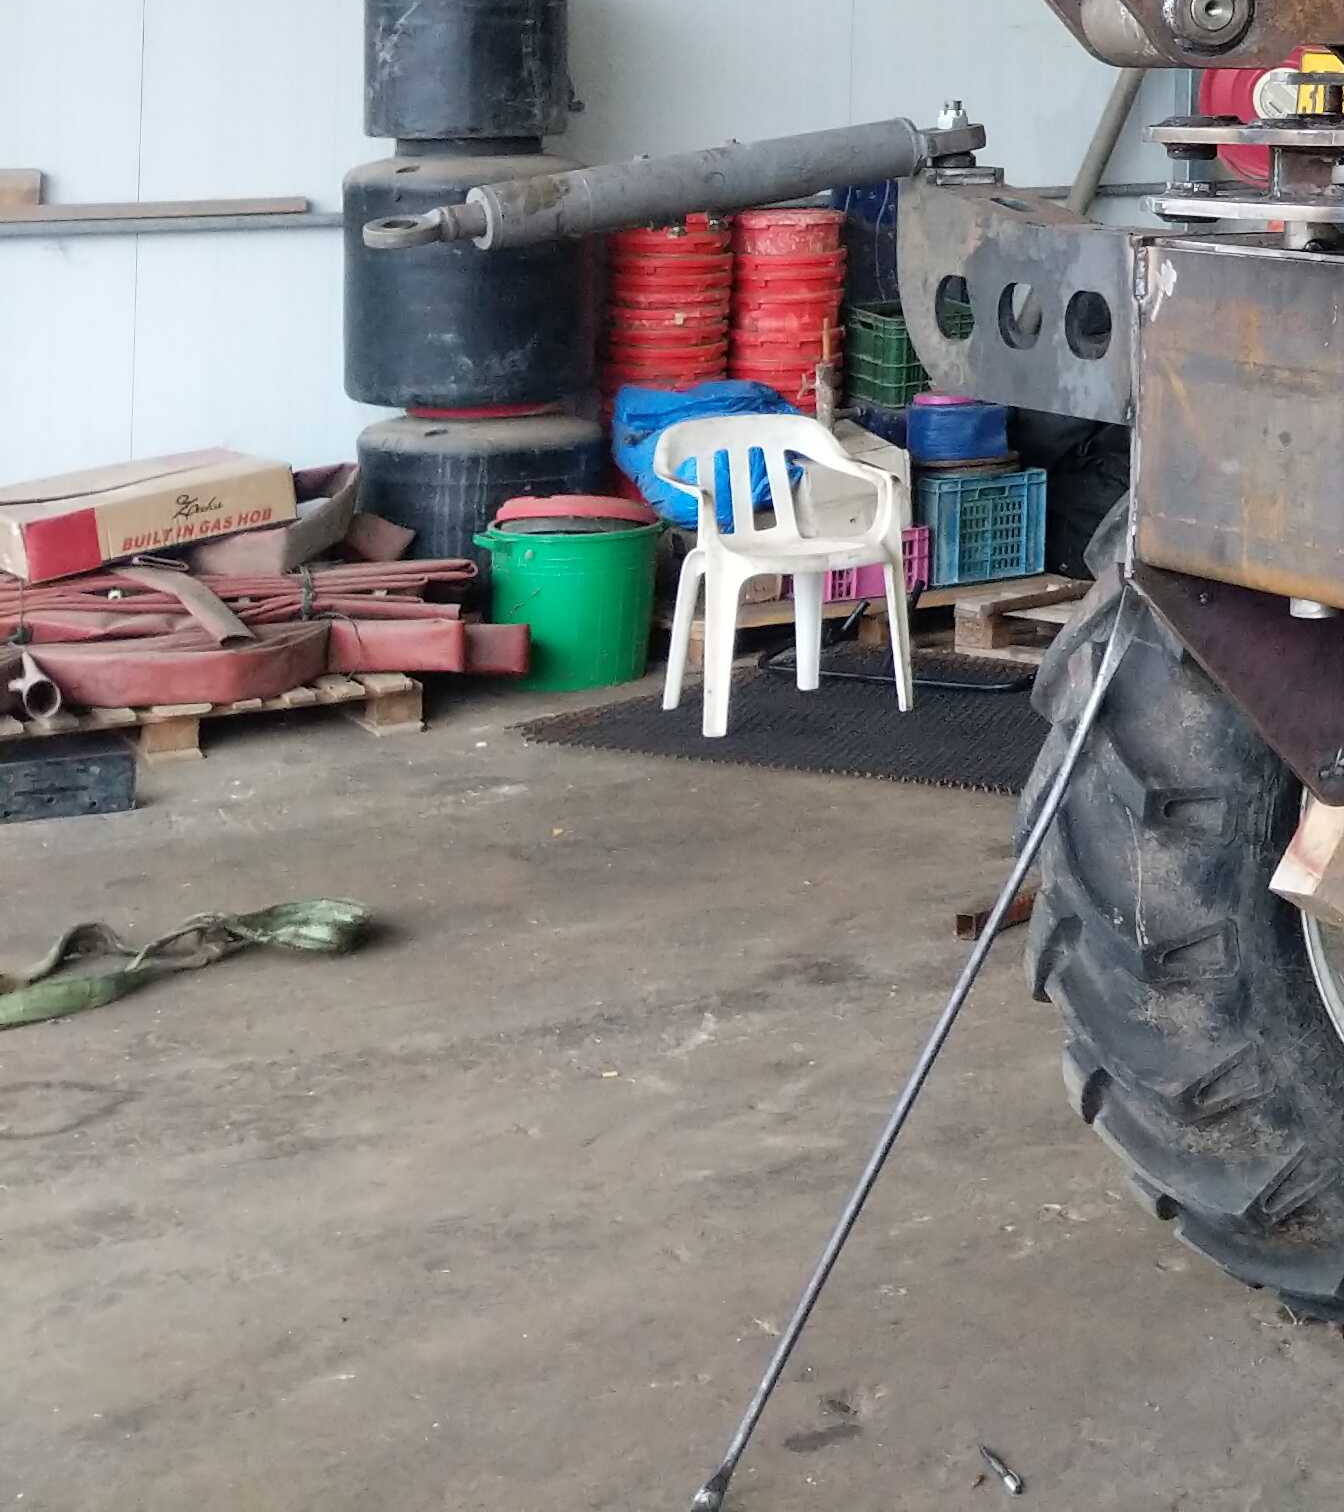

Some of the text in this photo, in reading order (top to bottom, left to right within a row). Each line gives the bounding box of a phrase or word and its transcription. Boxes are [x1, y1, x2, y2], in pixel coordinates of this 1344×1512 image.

[122, 527, 172, 551] BUILT
[176, 524, 195, 538] IN
[200, 516, 233, 532] GAS
[237, 507, 273, 525] HOB
